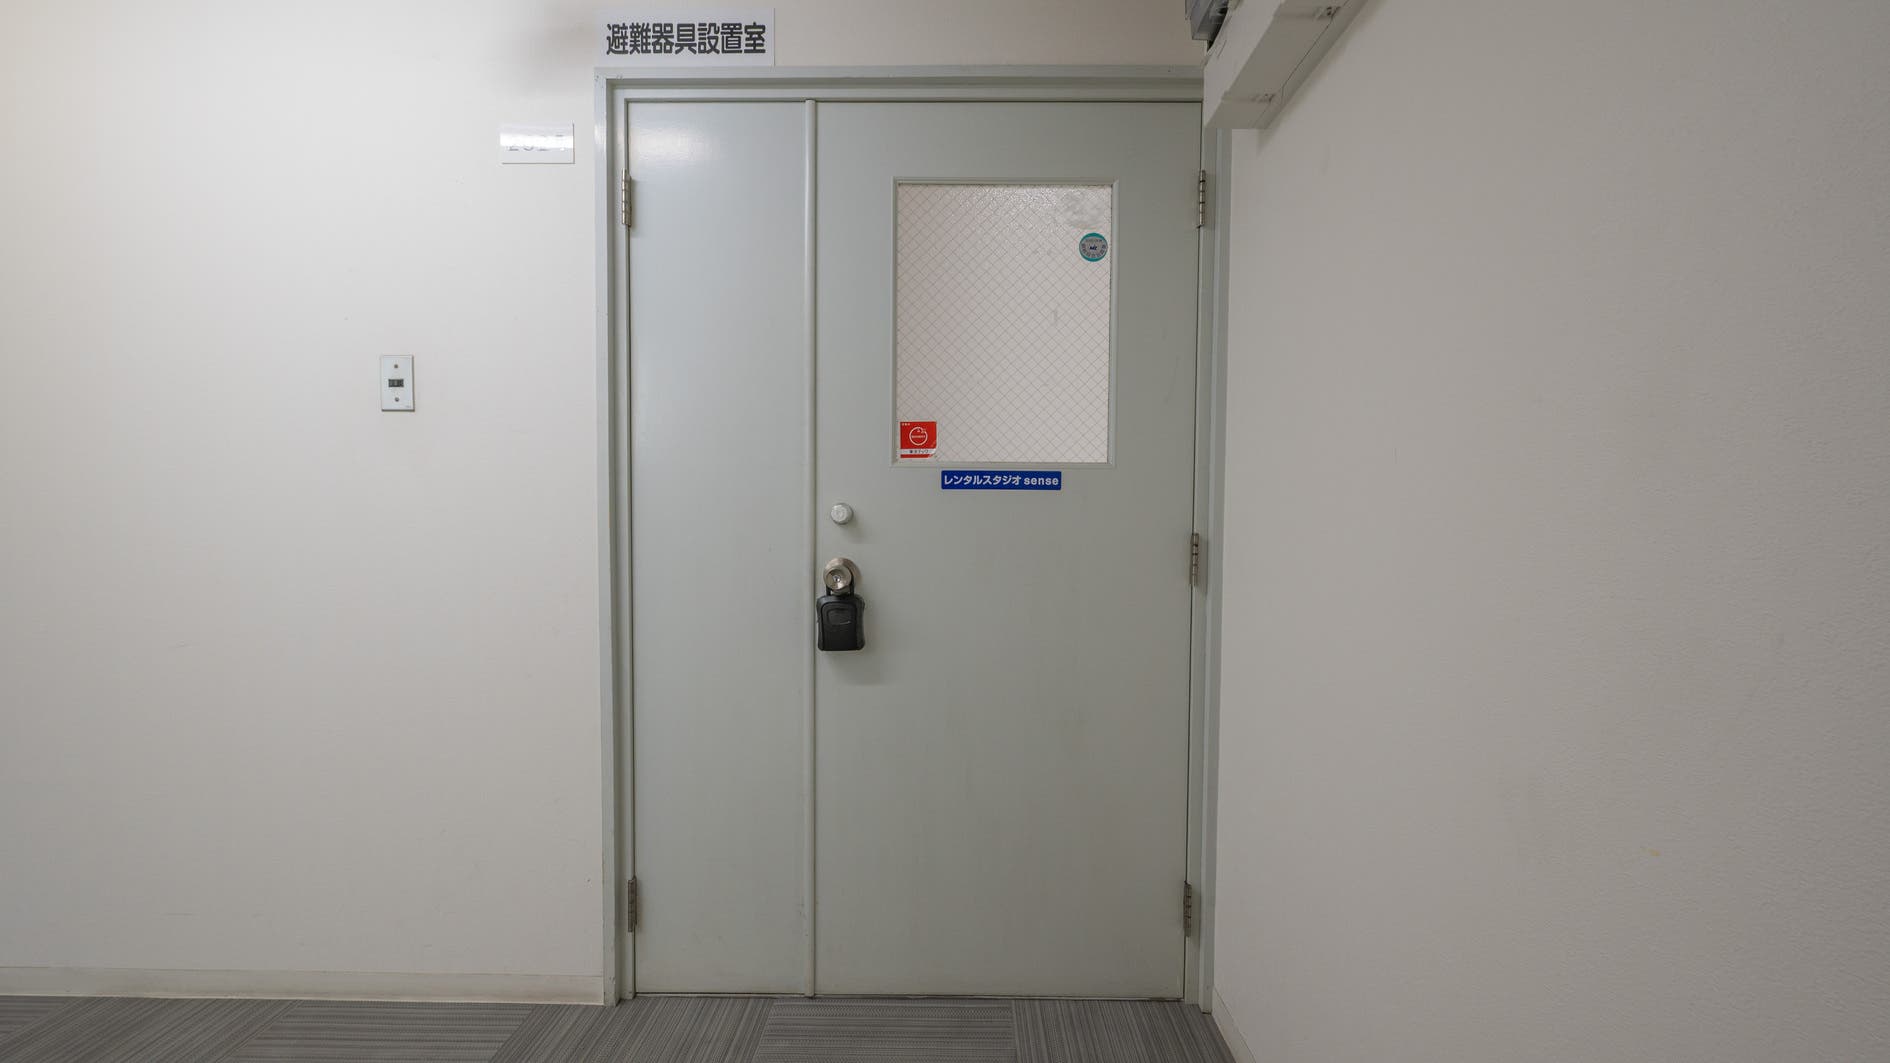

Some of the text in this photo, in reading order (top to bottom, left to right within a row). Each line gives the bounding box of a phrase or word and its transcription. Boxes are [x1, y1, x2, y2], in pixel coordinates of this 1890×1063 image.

[606, 22, 767, 55] 避難器具設置室
[944, 475, 1059, 486] レンタルスタジオ sense
